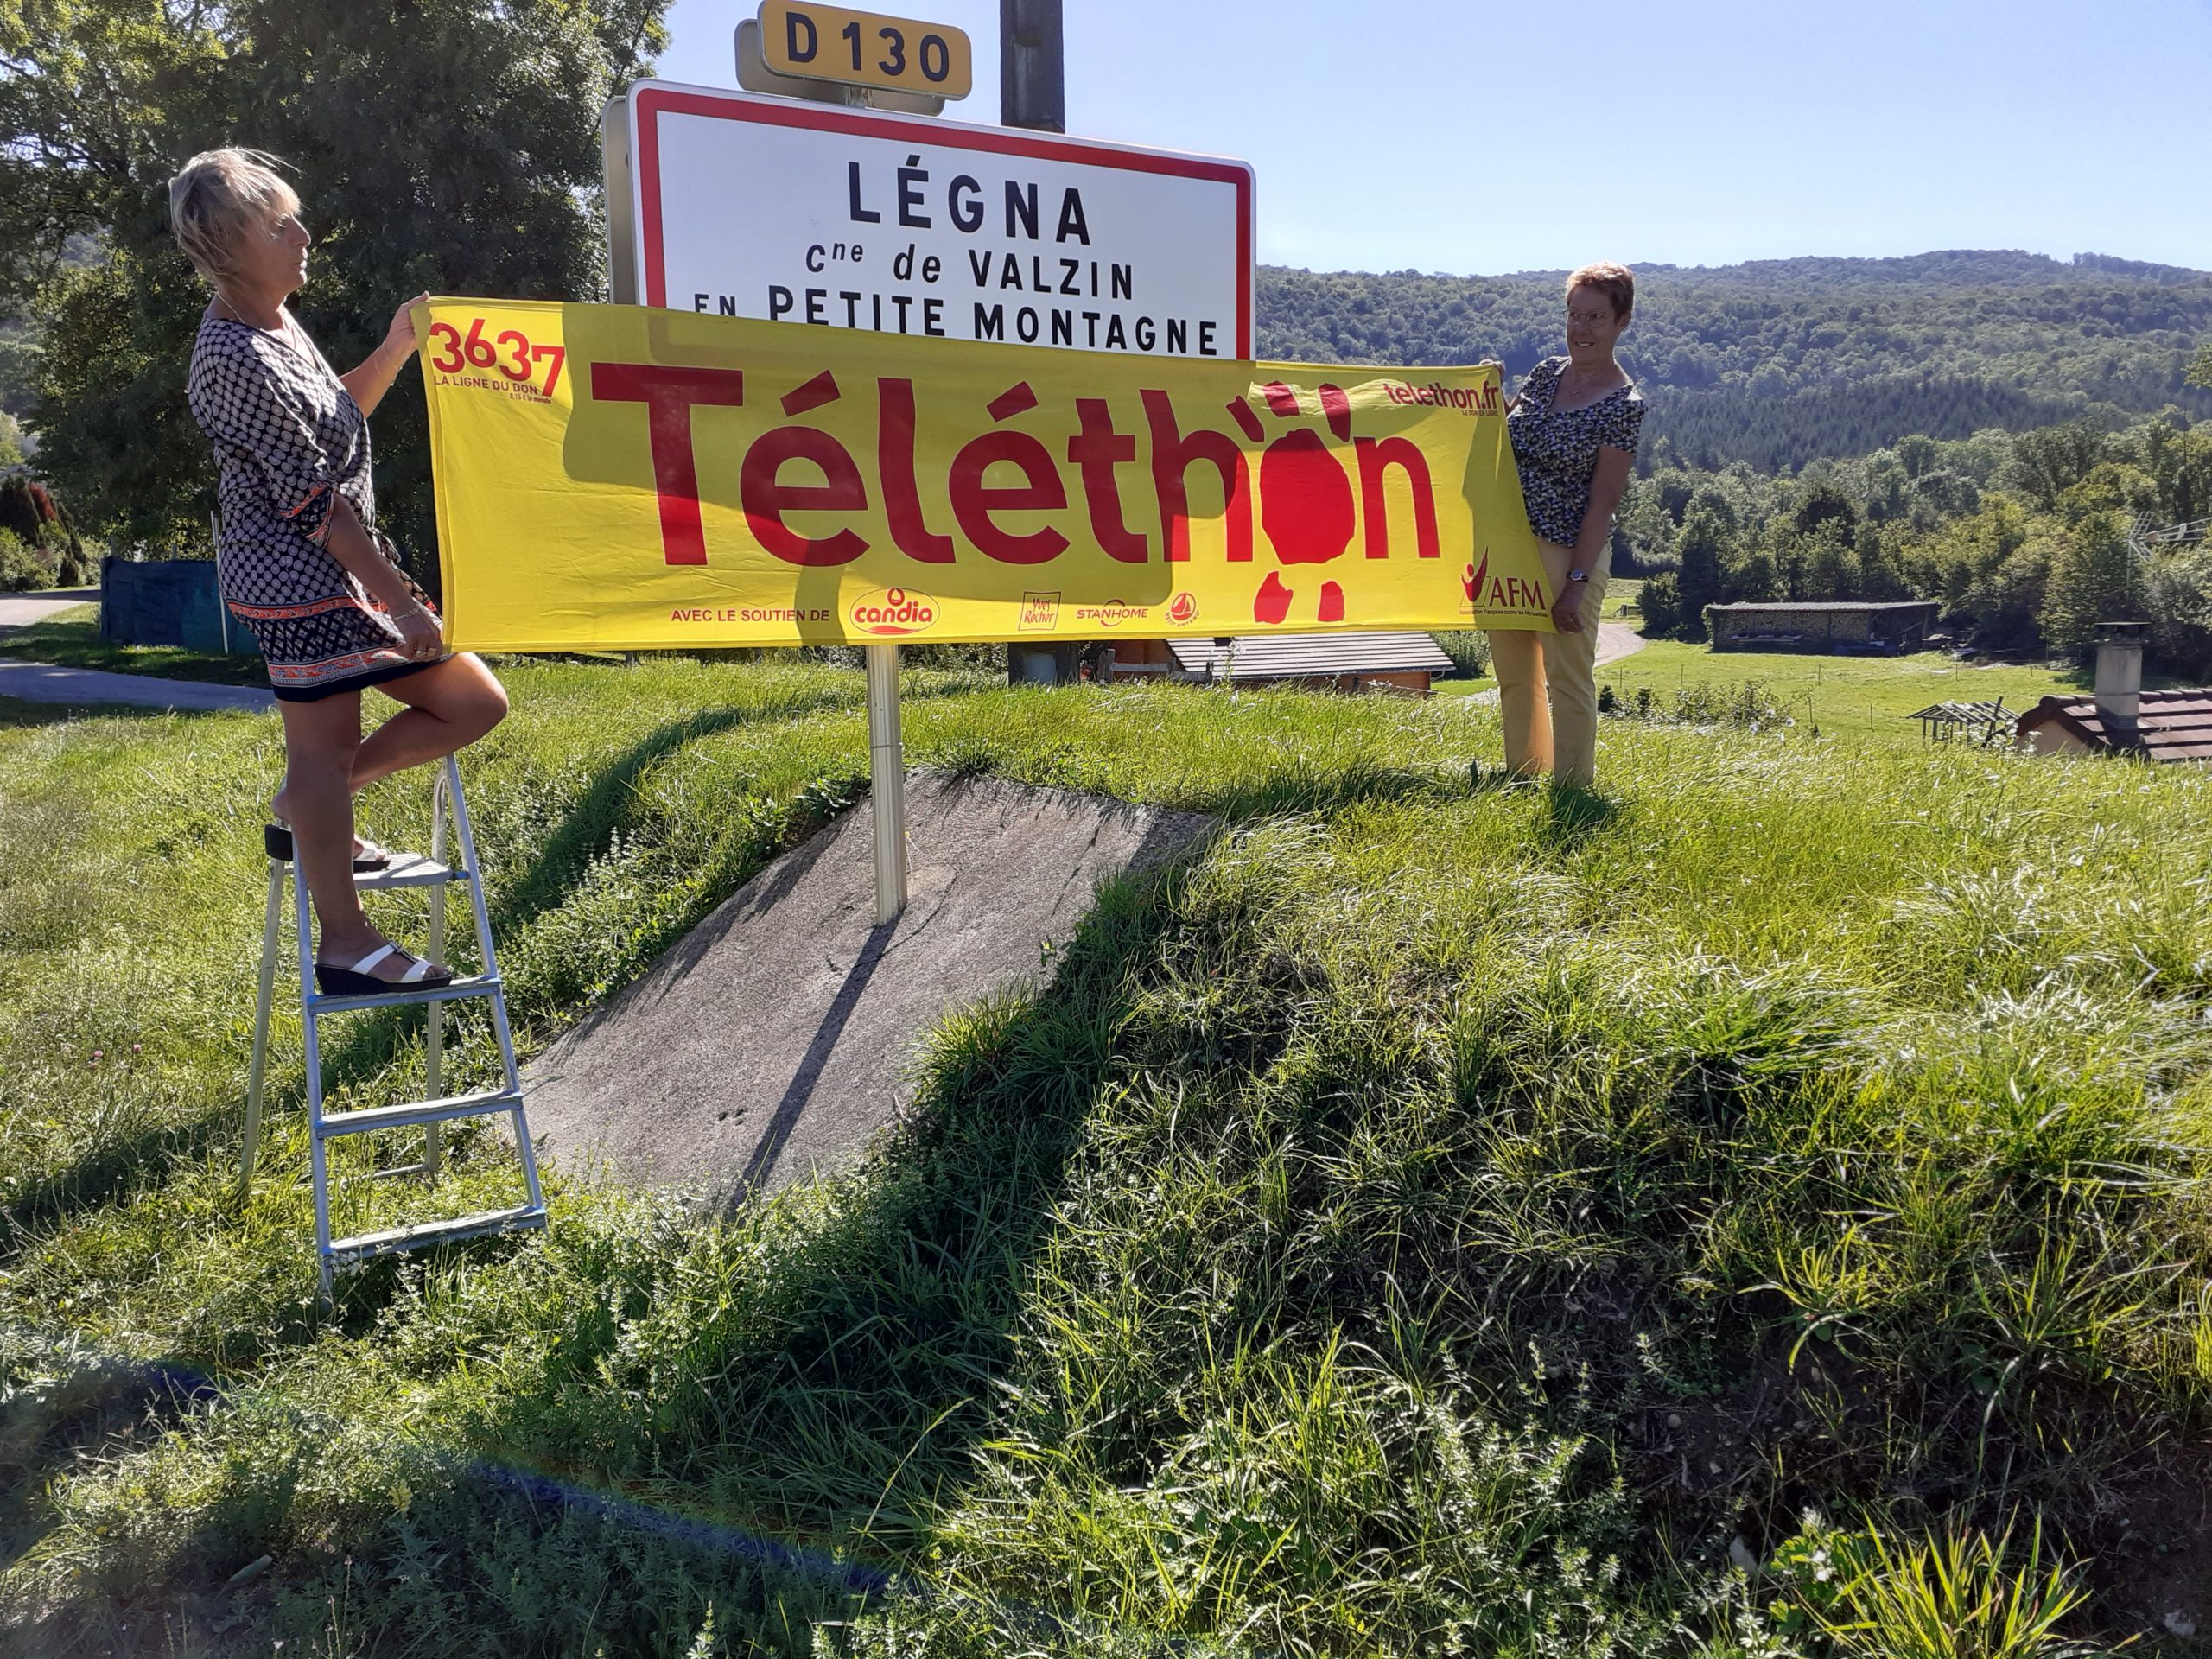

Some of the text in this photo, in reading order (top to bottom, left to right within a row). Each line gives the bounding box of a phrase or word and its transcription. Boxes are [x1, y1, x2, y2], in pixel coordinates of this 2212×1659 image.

[785, 11, 950, 82] D 130
[848, 155, 1092, 245] LÉGNA
[893, 244, 941, 282] de
[969, 249, 1132, 300] VALZIN
[694, 284, 1217, 355] EN PETITE MONTAGNE
[429, 318, 565, 397] 3637
[434, 375, 537, 395] LA LIGNE DU DON
[1382, 380, 1499, 409] telethon.fr
[591, 363, 1440, 567] Téléthon
[1033, 597, 1052, 611] Yves
[1489, 577, 1546, 610] AFM
[671, 609, 830, 621] AVEC LE SOUTIEN DE
[855, 601, 933, 623] candia
[1024, 610, 1055, 624] Rocher
[1077, 608, 1149, 620] STANHOME
